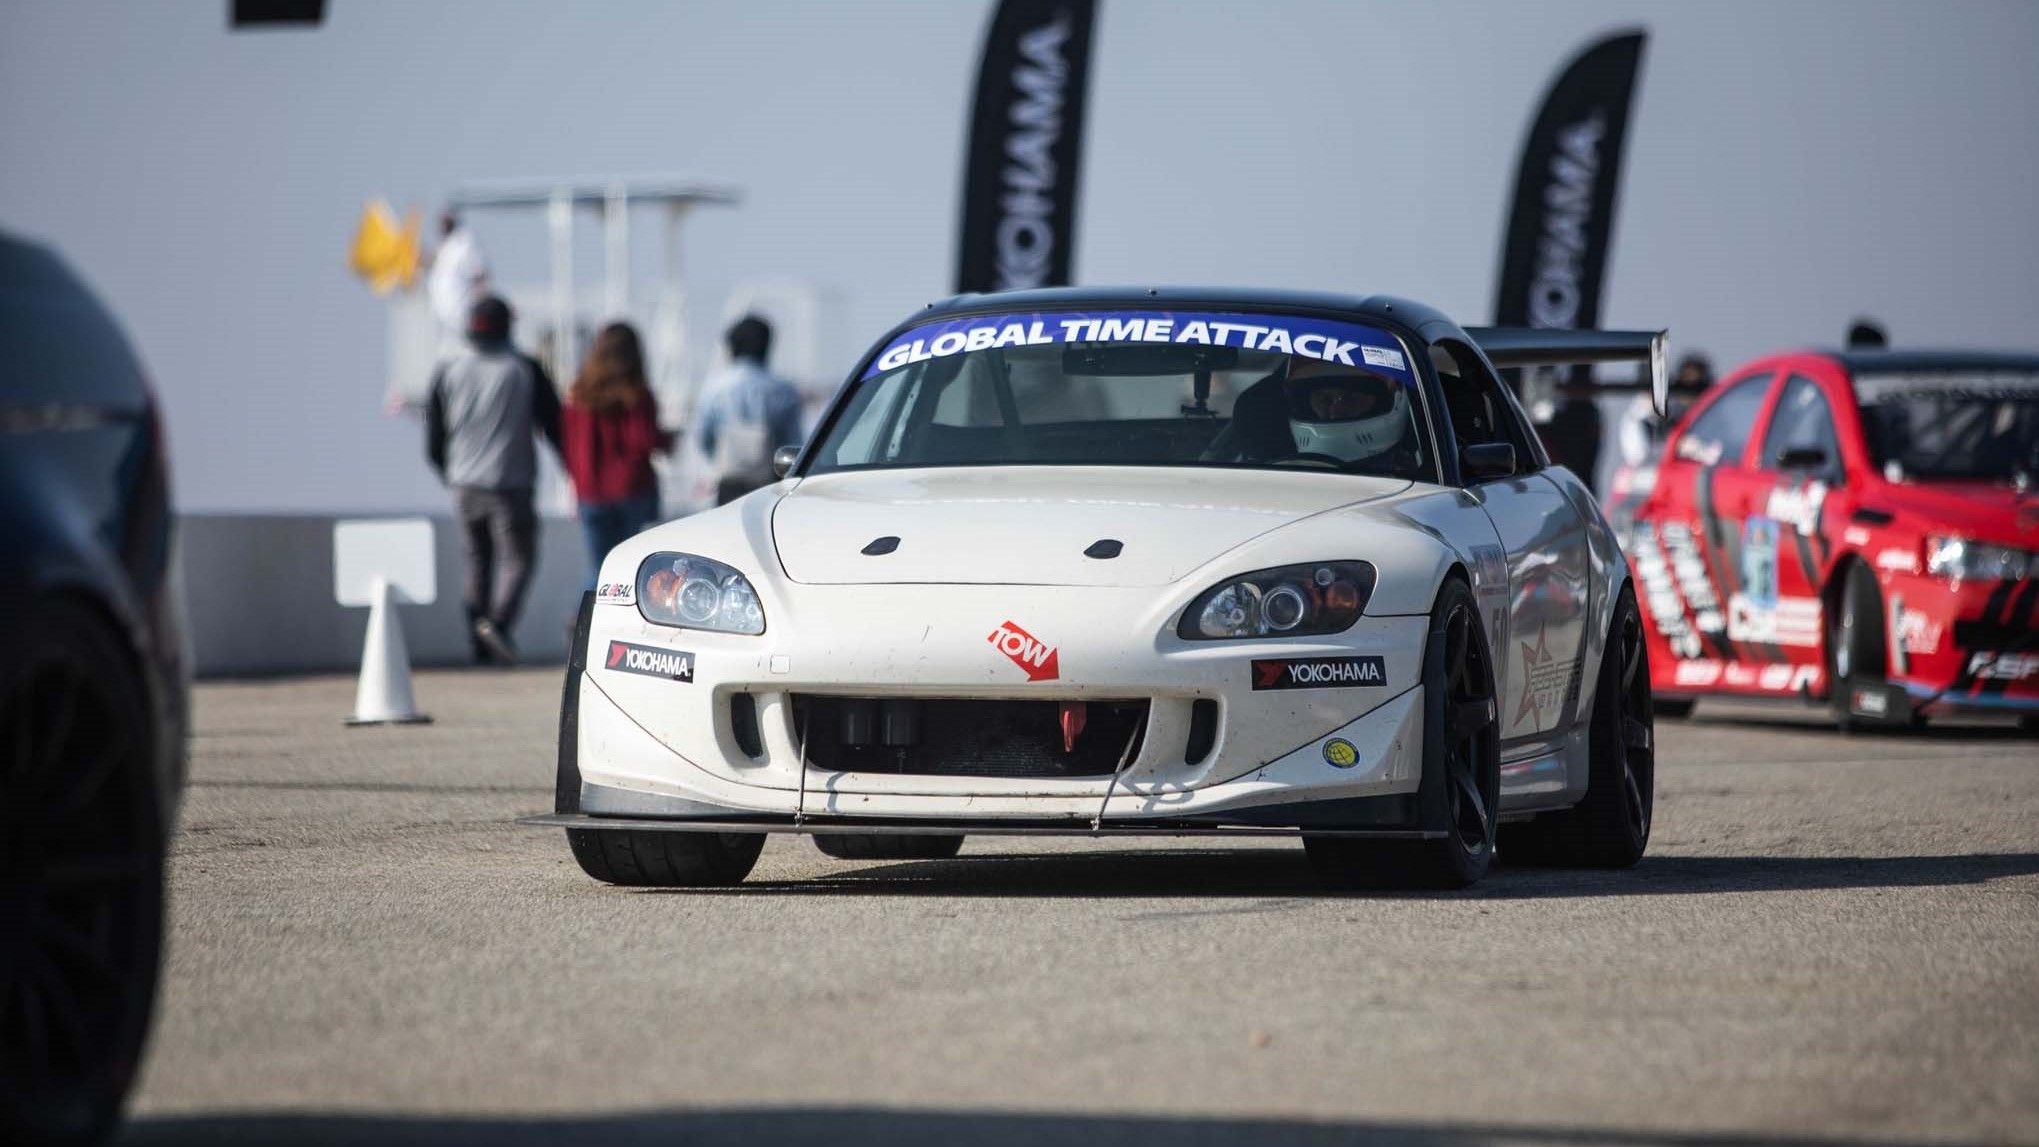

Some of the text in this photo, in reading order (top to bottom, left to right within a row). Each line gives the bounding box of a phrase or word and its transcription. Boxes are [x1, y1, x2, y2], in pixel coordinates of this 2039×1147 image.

[878, 319, 1361, 371] GLOBAL TIME ATTACK
[626, 648, 689, 677] YOKOHAMA
[988, 626, 1053, 668] TOW
[1287, 662, 1380, 683] YOKOHAMA
